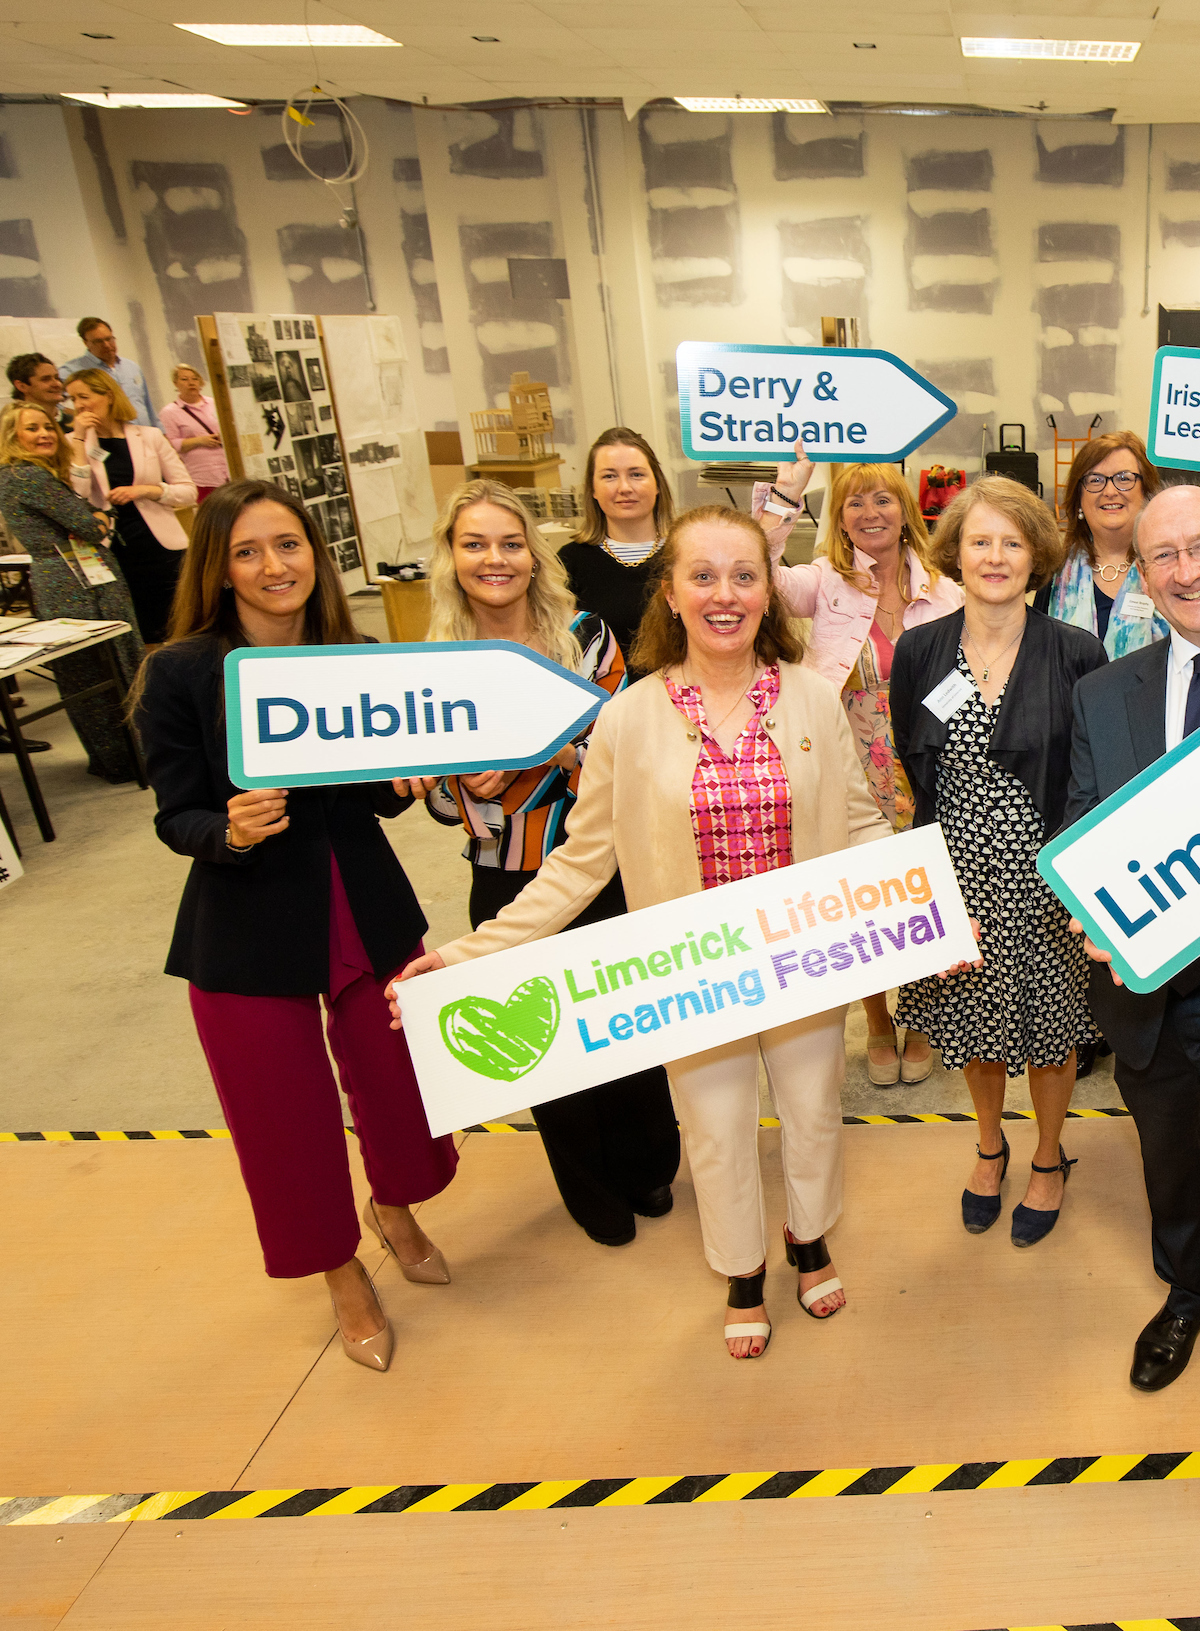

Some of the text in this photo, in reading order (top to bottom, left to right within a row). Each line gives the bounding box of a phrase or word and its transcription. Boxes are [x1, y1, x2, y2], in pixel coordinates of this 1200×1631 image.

[697, 368, 839, 407] Derry &
[698, 411, 868, 445] Strabane
[256, 687, 478, 744] Dublin
[564, 867, 933, 1003] Limerick Lifelong
[576, 900, 946, 1053] Learning Festival
